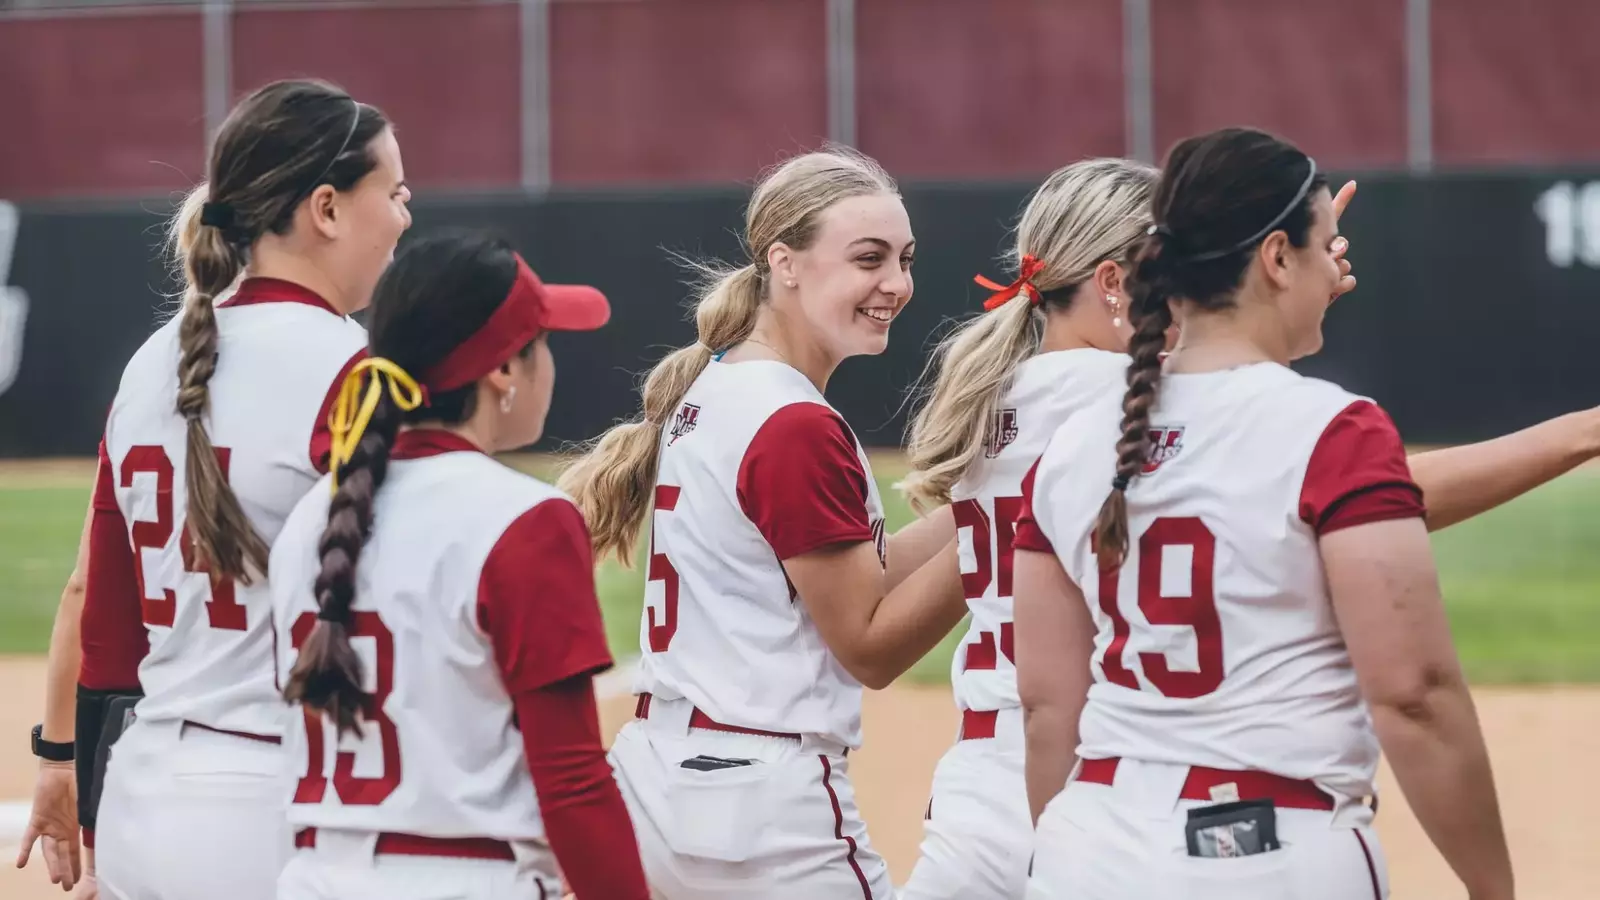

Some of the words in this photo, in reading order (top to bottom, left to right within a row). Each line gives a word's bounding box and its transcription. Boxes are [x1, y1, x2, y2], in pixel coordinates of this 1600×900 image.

[121, 445, 248, 631] 24
[647, 484, 682, 653] 5
[1091, 516, 1225, 698] 19
